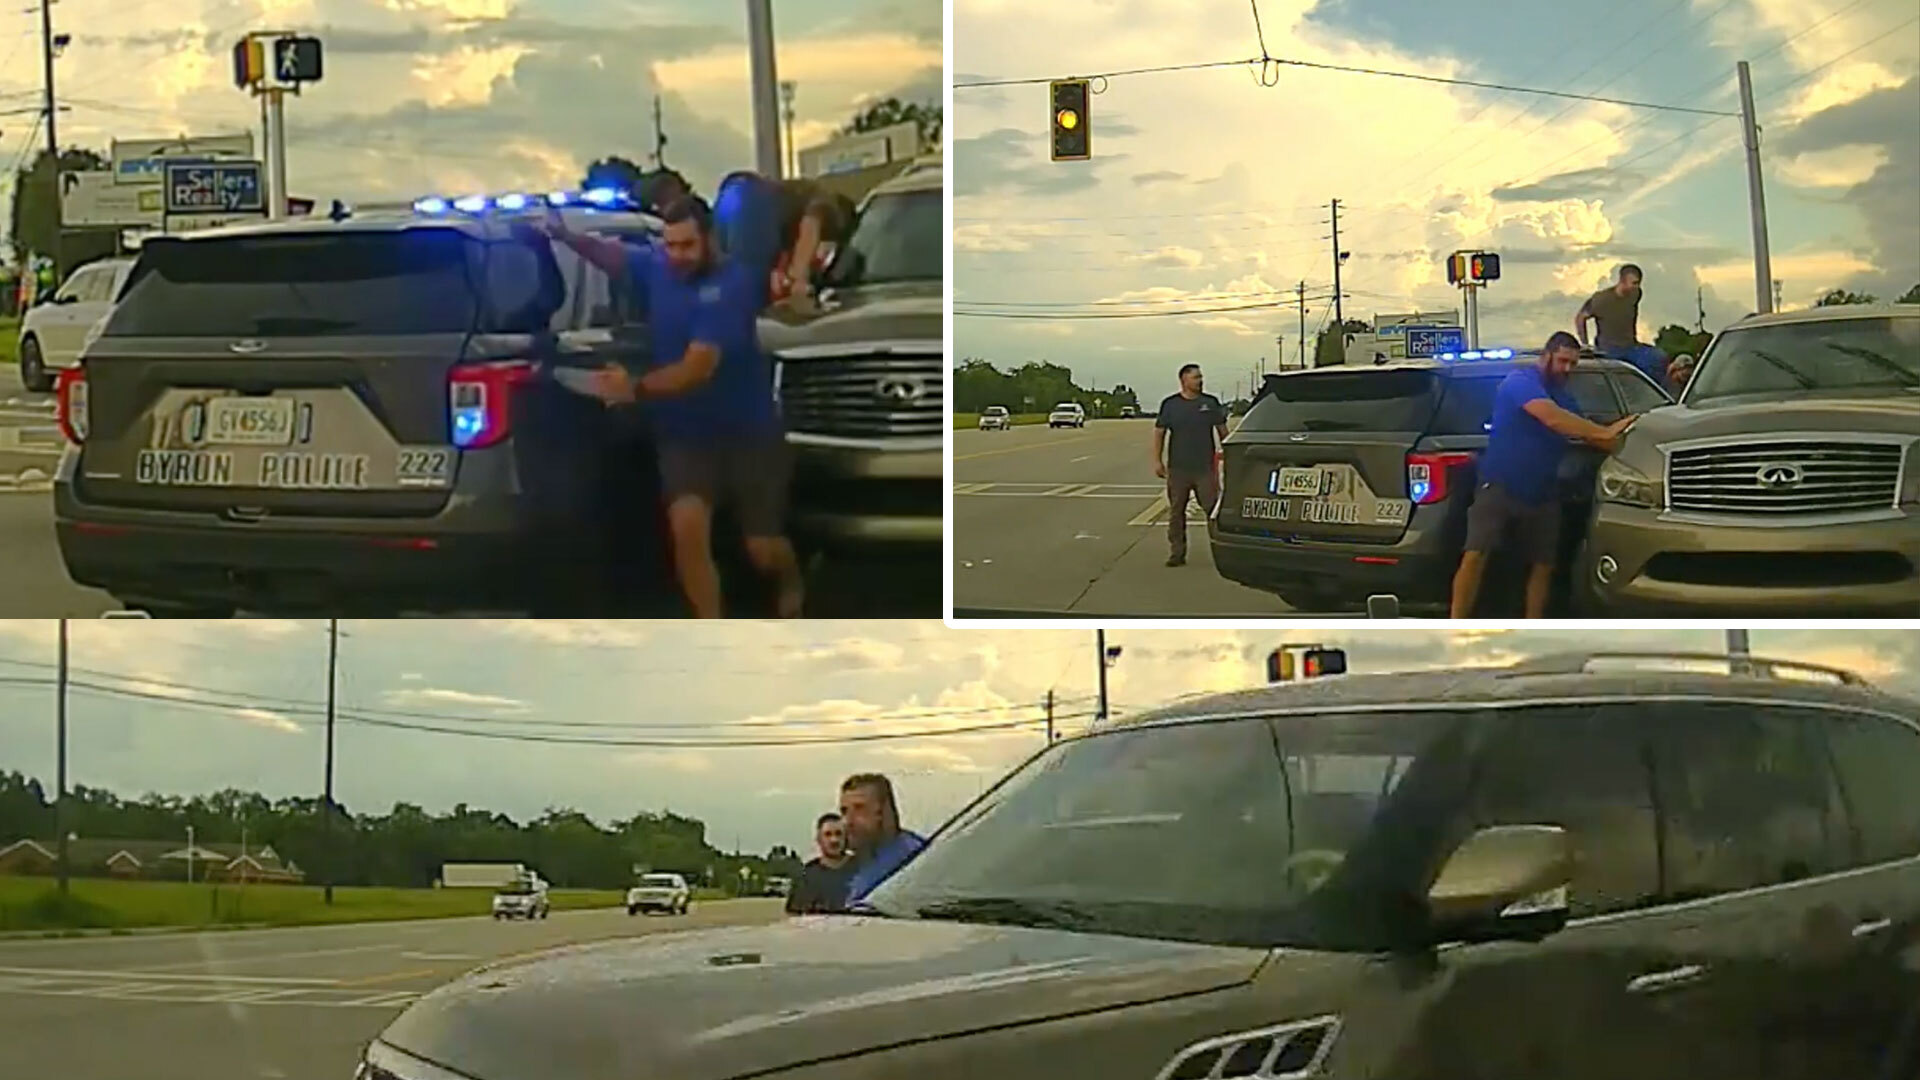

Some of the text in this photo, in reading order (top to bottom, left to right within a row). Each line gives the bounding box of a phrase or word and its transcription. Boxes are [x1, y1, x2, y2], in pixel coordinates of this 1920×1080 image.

[187, 170, 254, 190] Sellers
[175, 185, 241, 209] Realty
[1420, 332, 1460, 344] Sellers
[138, 450, 369, 489] BYRON POLICE
[399, 451, 448, 475] 222
[1242, 497, 1359, 523] BYRON POLICE
[1376, 502, 1404, 516] 222
